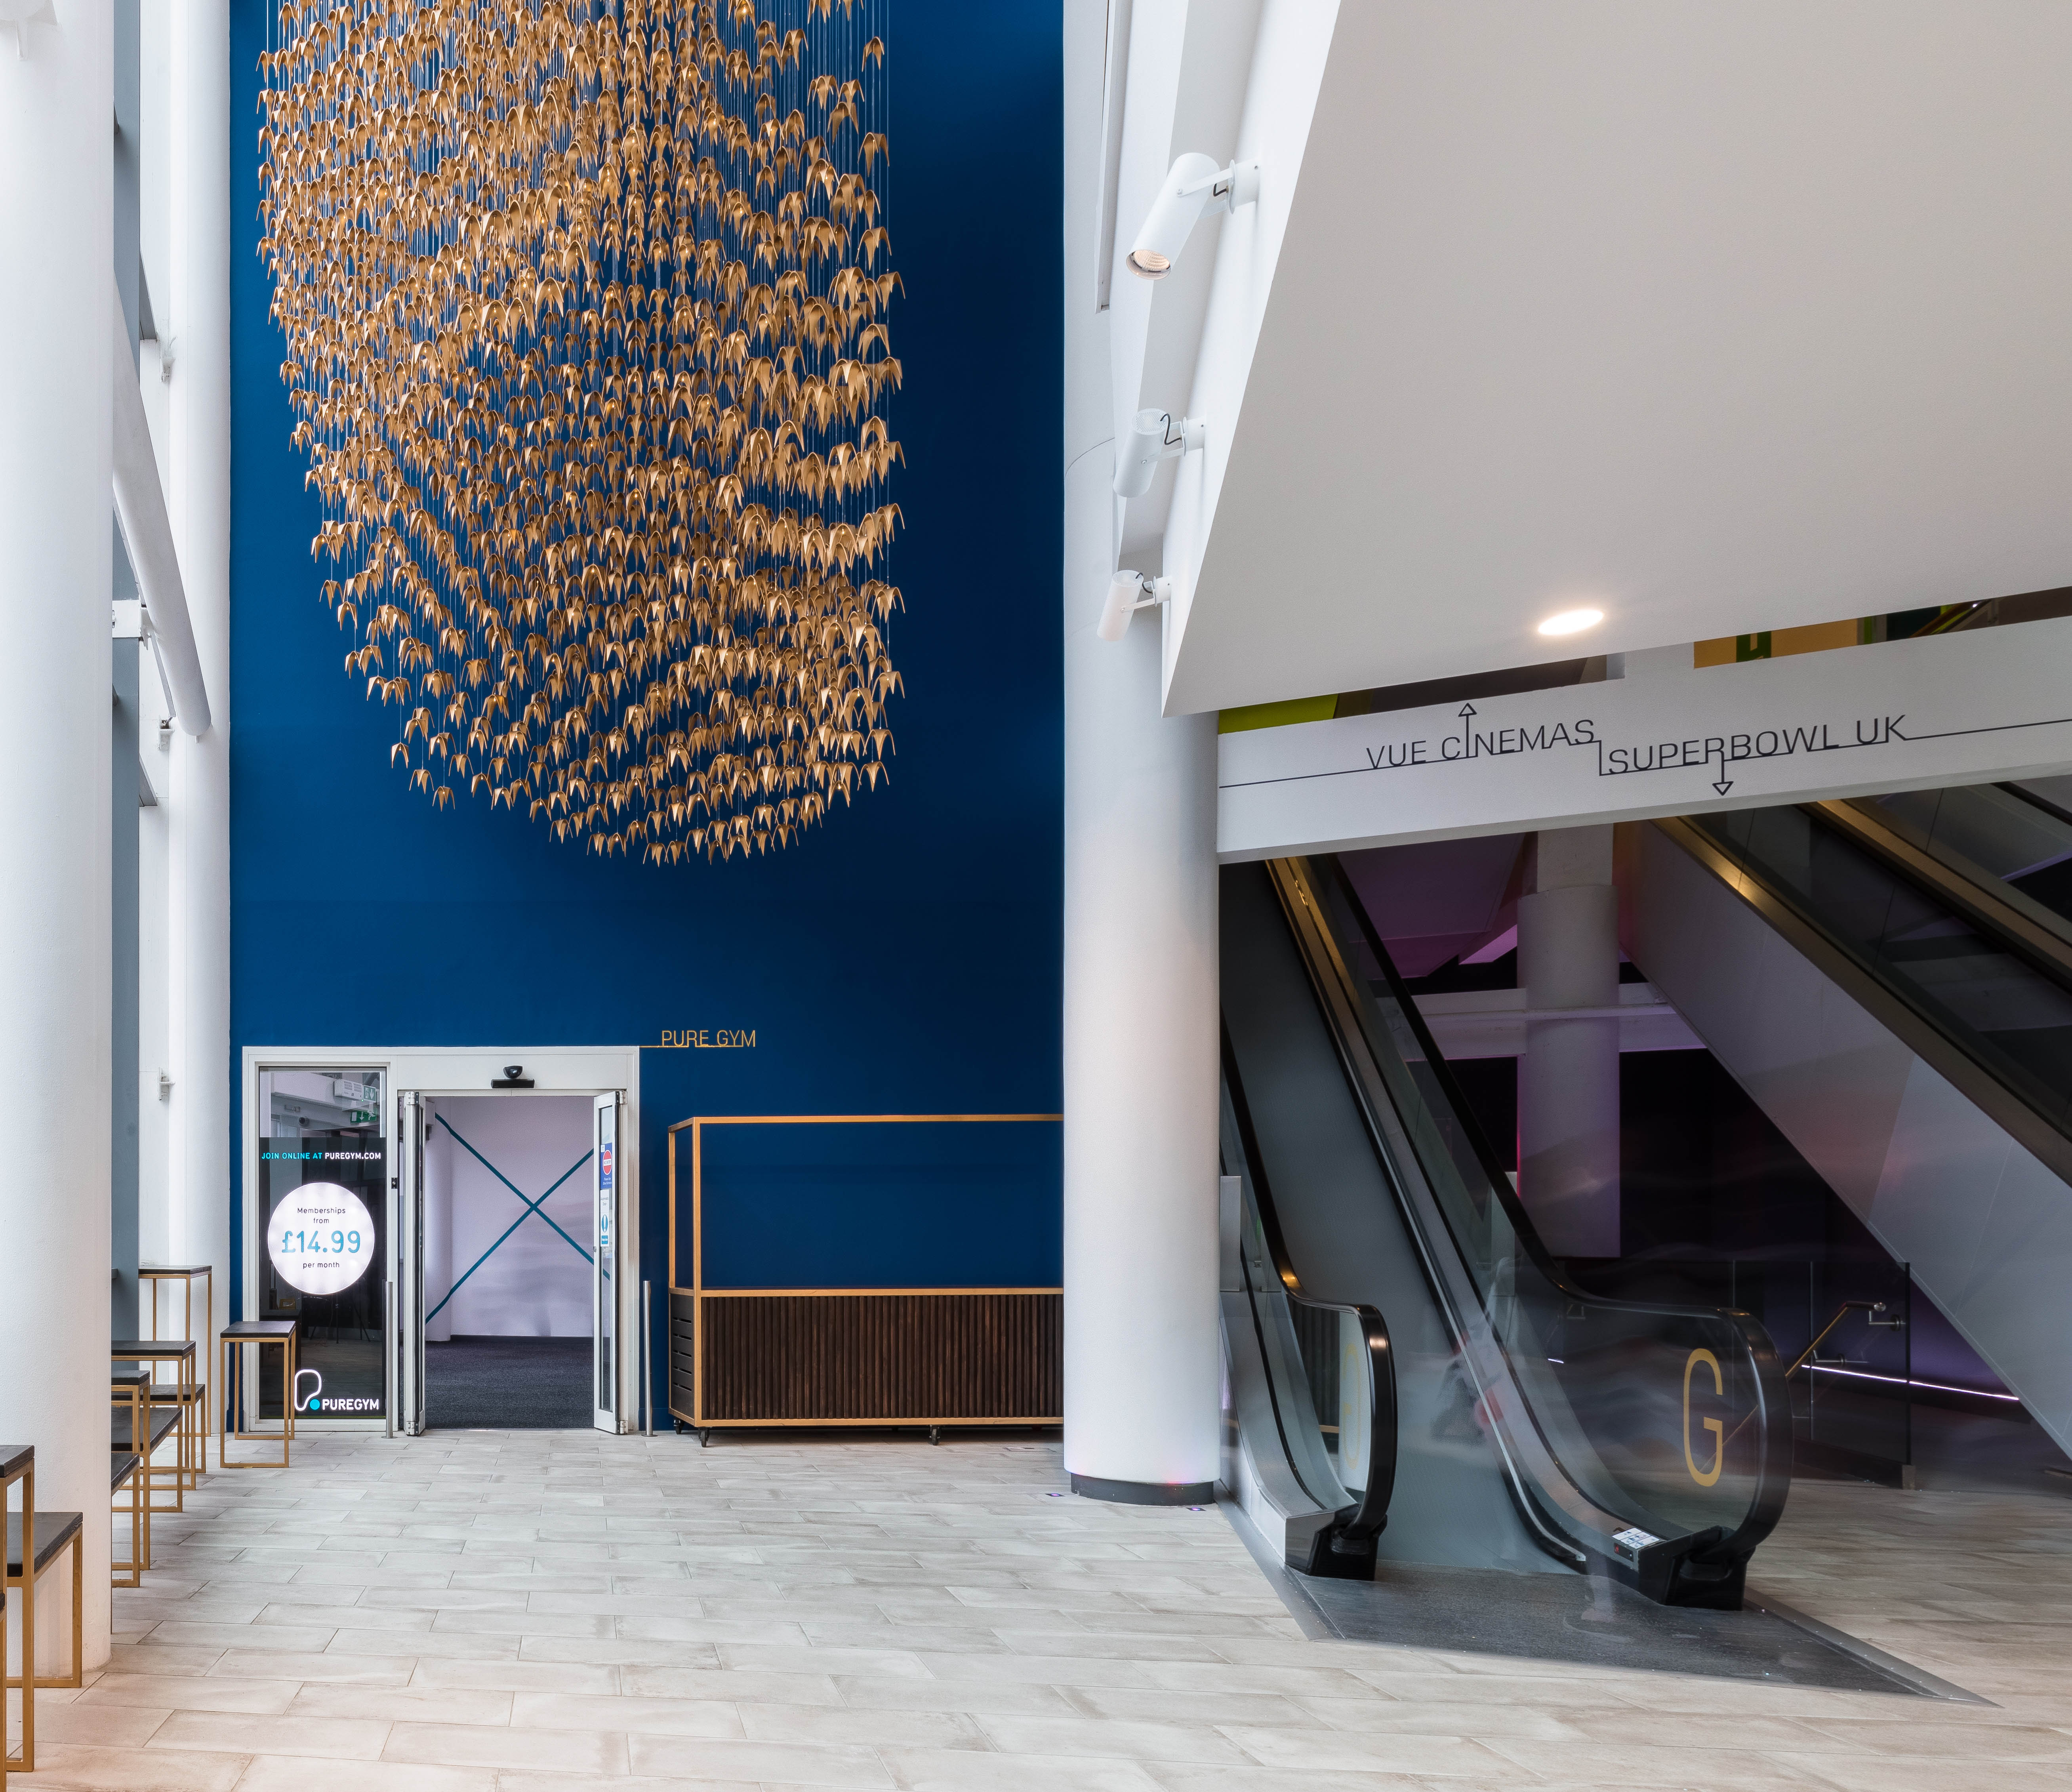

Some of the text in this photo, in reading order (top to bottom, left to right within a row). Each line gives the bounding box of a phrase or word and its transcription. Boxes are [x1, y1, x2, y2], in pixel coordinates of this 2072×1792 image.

[1366, 715, 1595, 769] VUE CINEMAS
[1608, 714, 1906, 775] SUPERBOWL UK
[662, 1030, 755, 1047] PURE GYM
[282, 1230, 360, 1253] £14.99
[322, 1399, 379, 1410] PUREGYM
[1683, 1348, 1723, 1487] G
